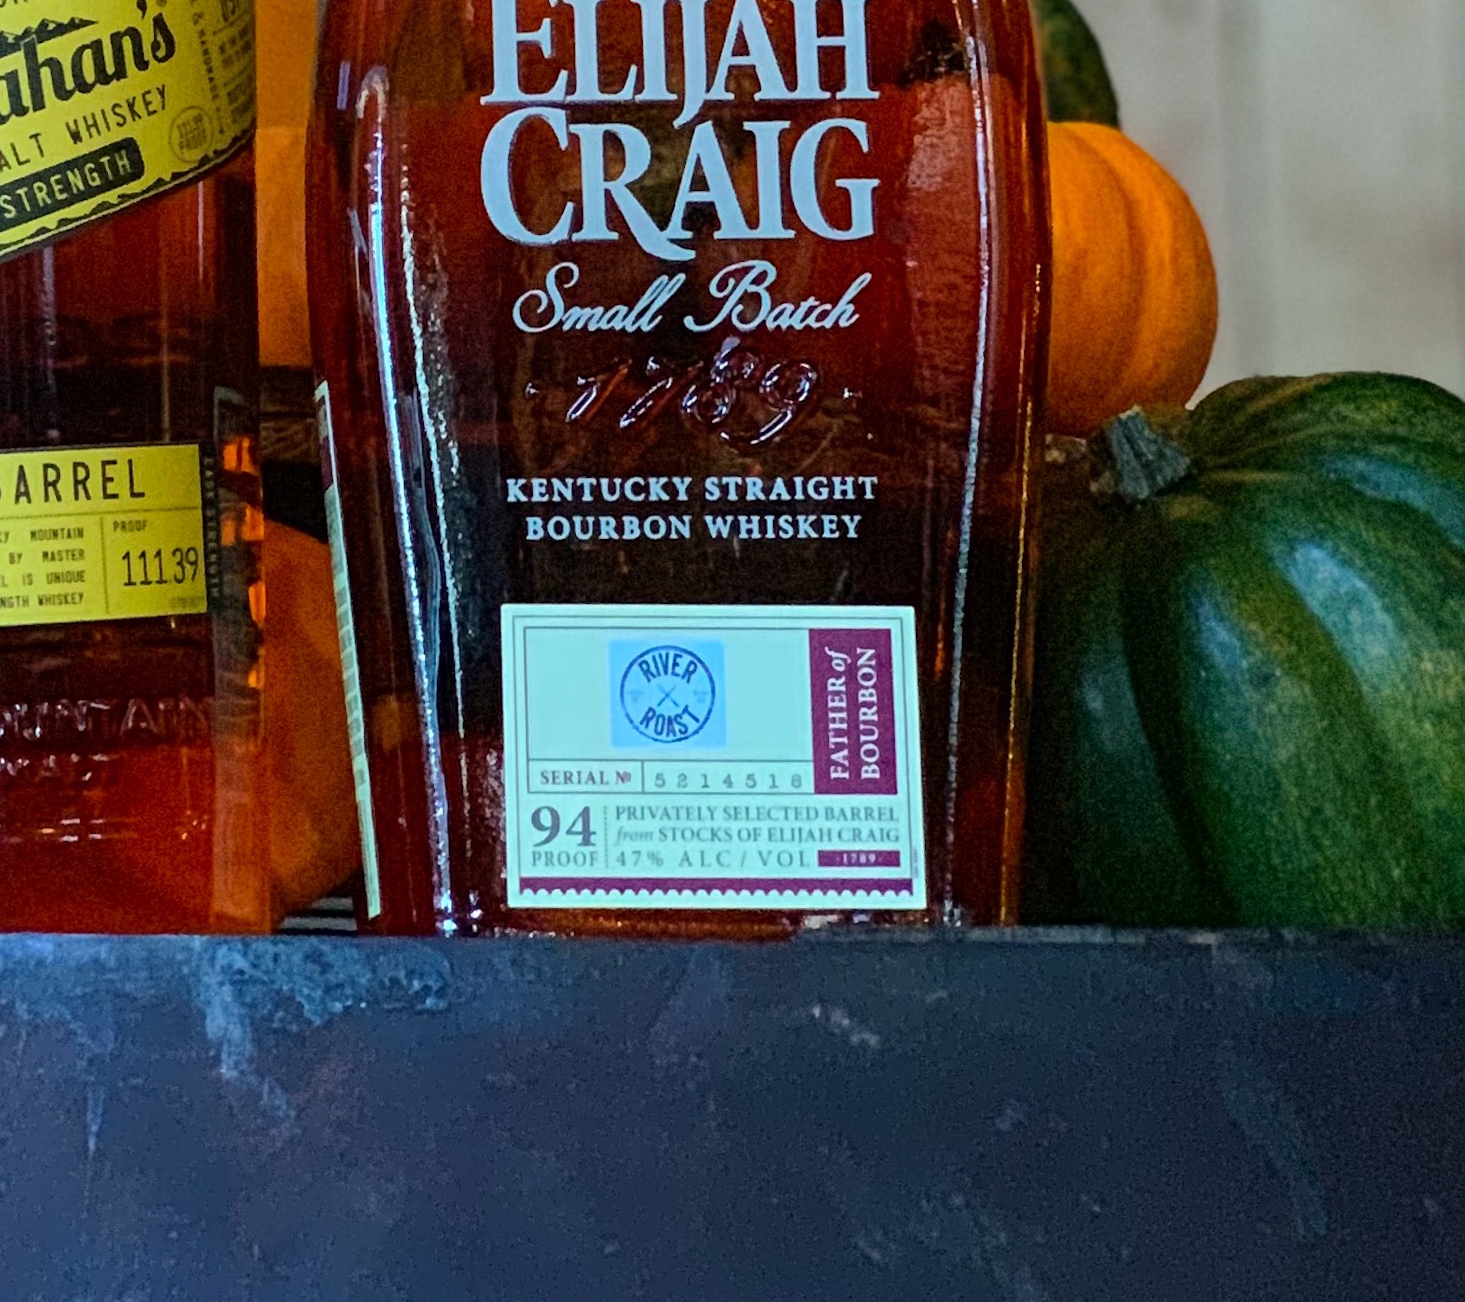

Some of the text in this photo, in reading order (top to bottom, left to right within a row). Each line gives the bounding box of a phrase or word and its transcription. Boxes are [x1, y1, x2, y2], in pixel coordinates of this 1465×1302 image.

[66, 84, 169, 145] WHISKEY
[3, 151, 132, 218] STRENGTH
[480, 106, 880, 261] CRAIG
[512, 260, 872, 333] Small Batch
[507, 476, 878, 503] KENTUCKY STRAIGHT
[30, 527, 84, 541] MOUNTAIN
[113, 520, 148, 533] PROOF
[526, 514, 862, 541] BOURBON WHISKEY
[9, 552, 23, 565] BY
[42, 549, 84, 562] MASTER
[22, 573, 33, 586] IS
[46, 570, 86, 584] UNIQUE
[38, 593, 84, 607] WHISKEY
[638, 652, 697, 683] RIVER
[640, 704, 700, 737] ROAST
[825, 646, 851, 780] FATHER of
[857, 647, 880, 779] BOURBON
[540, 770, 610, 785] SERIAL
[615, 806, 899, 822] PRIVATELY SELECTED BARREL
[531, 806, 596, 847] 94
[615, 827, 900, 845] from STOCKS OF ELIJAH CRAIG
[532, 851, 598, 867] PROOF
[616, 850, 664, 867] 47%
[842, 853, 876, 864] 1789
